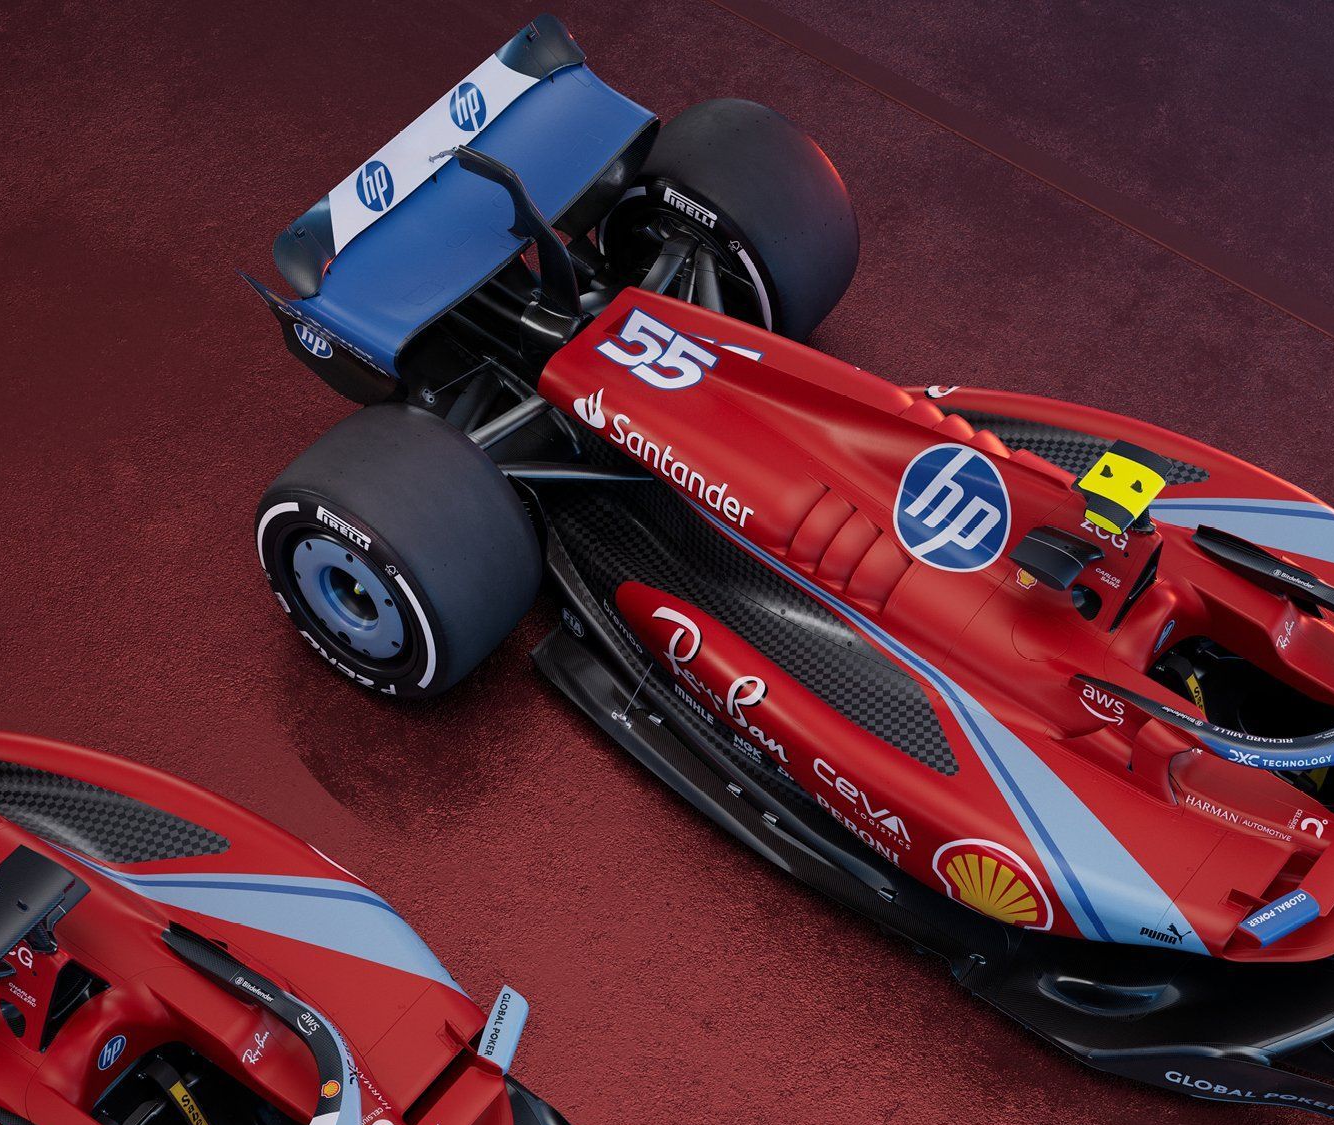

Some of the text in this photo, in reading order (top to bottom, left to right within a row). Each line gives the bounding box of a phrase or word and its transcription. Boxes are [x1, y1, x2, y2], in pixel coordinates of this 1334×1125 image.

[451, 83, 486, 131] hp
[357, 161, 393, 211] hp
[663, 187, 717, 229] PIRELLI
[298, 324, 330, 357] hp
[595, 306, 720, 390] 55
[609, 413, 756, 529] Santander
[899, 444, 1007, 564] hp
[316, 505, 372, 551] PIRELLI
[1095, 567, 1122, 584] CARLOS
[1101, 576, 1120, 589] SAINZ
[1281, 572, 1315, 589] Bitdefender
[603, 599, 643, 654] brembo
[674, 683, 714, 726] MAHLE
[1082, 684, 1124, 714] aws
[1162, 705, 1195, 724] Bitdefender
[734, 734, 762, 759] NGK
[1213, 725, 1293, 744] RICHARD MILLE
[1228, 749, 1332, 767] DXC TECHNOLOGY
[854, 808, 910, 850] LOGISTICS
[1186, 794, 1292, 842] HARMAN AUTOMOTIVE
[1289, 809, 1303, 830] CELSIUS
[1247, 893, 1307, 927] GLOBAL POKER
[8, 982, 37, 1002] CHARLES
[9, 988, 36, 1007] LECLERC
[242, 980, 274, 1002] Bitdefender
[301, 1012, 321, 1032] aws
[484, 993, 511, 1056] GLOBAL POKER
[99, 1036, 125, 1069] hp
[1165, 1071, 1256, 1098] GLOBAL
